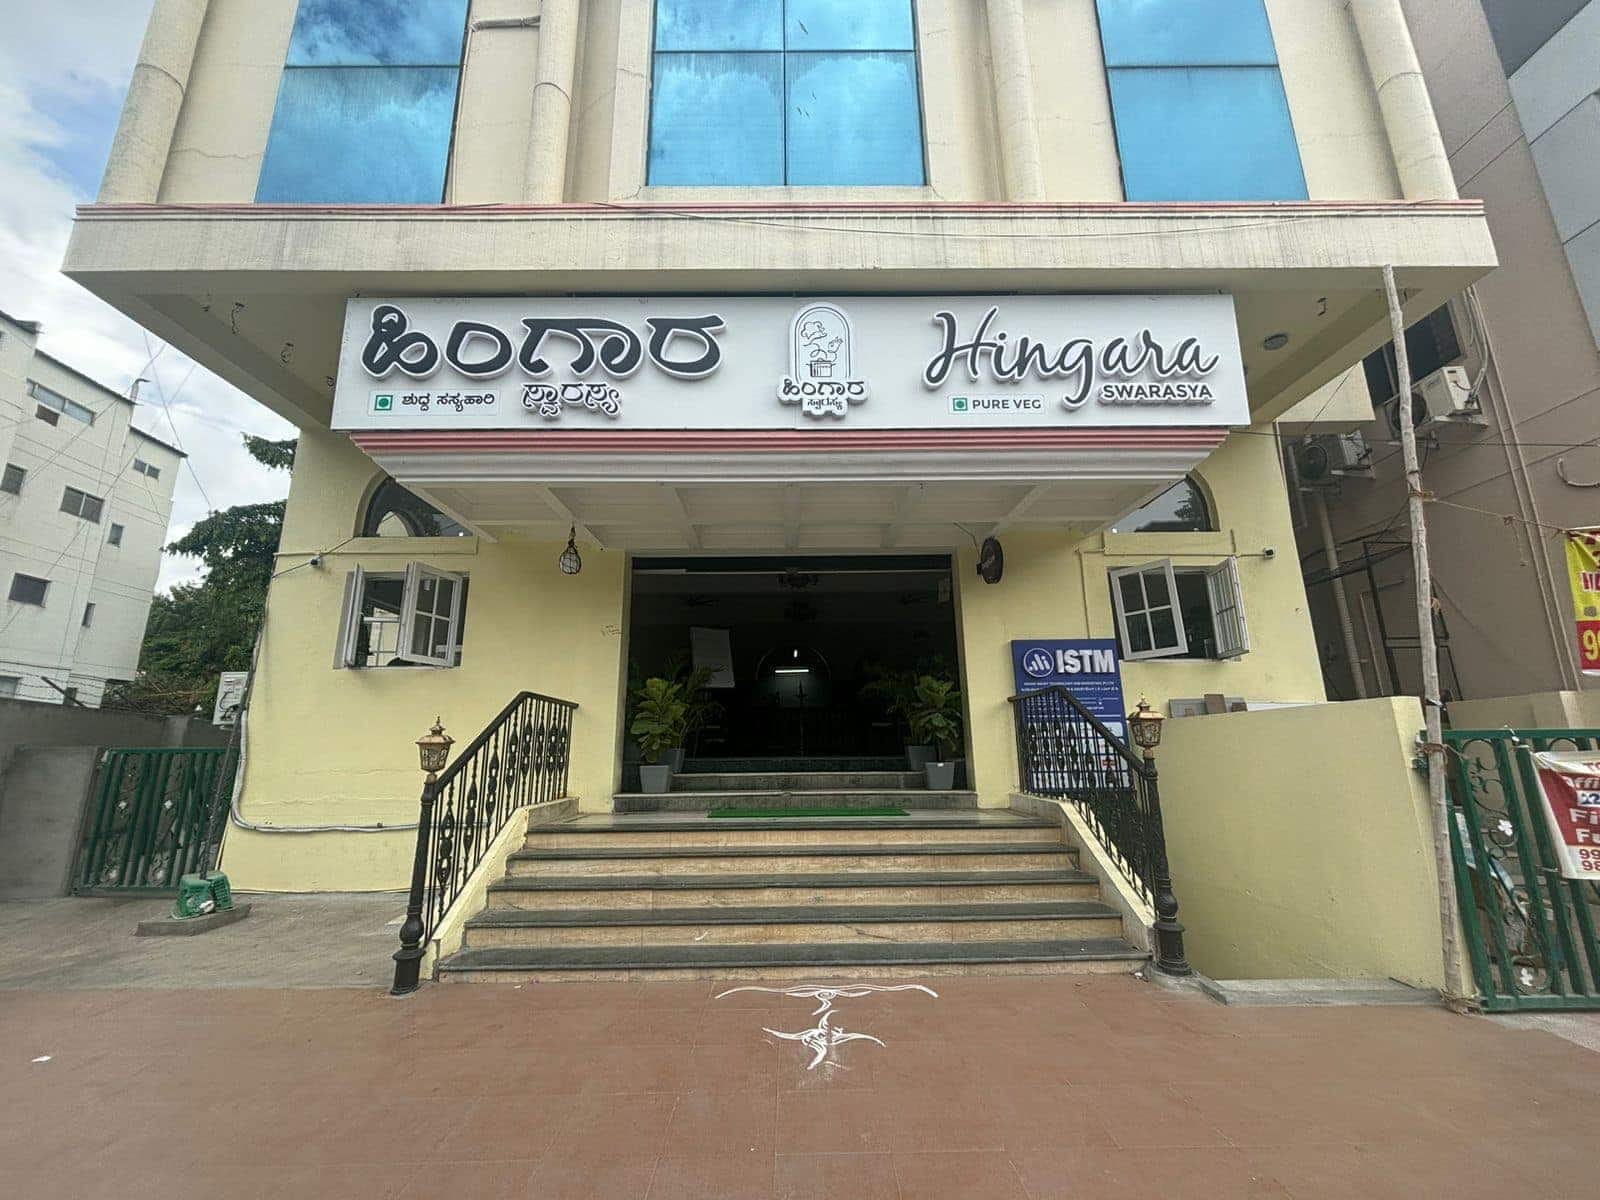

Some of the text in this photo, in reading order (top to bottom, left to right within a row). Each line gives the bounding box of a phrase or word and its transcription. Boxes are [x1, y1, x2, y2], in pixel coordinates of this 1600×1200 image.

[361, 304, 725, 377] ಹಿಂಗಾರ
[925, 307, 1220, 404] Hingara
[1102, 383, 1213, 399] SWARASYA
[972, 399, 1042, 410] PURE VEG
[1055, 649, 1116, 674] ISTM
